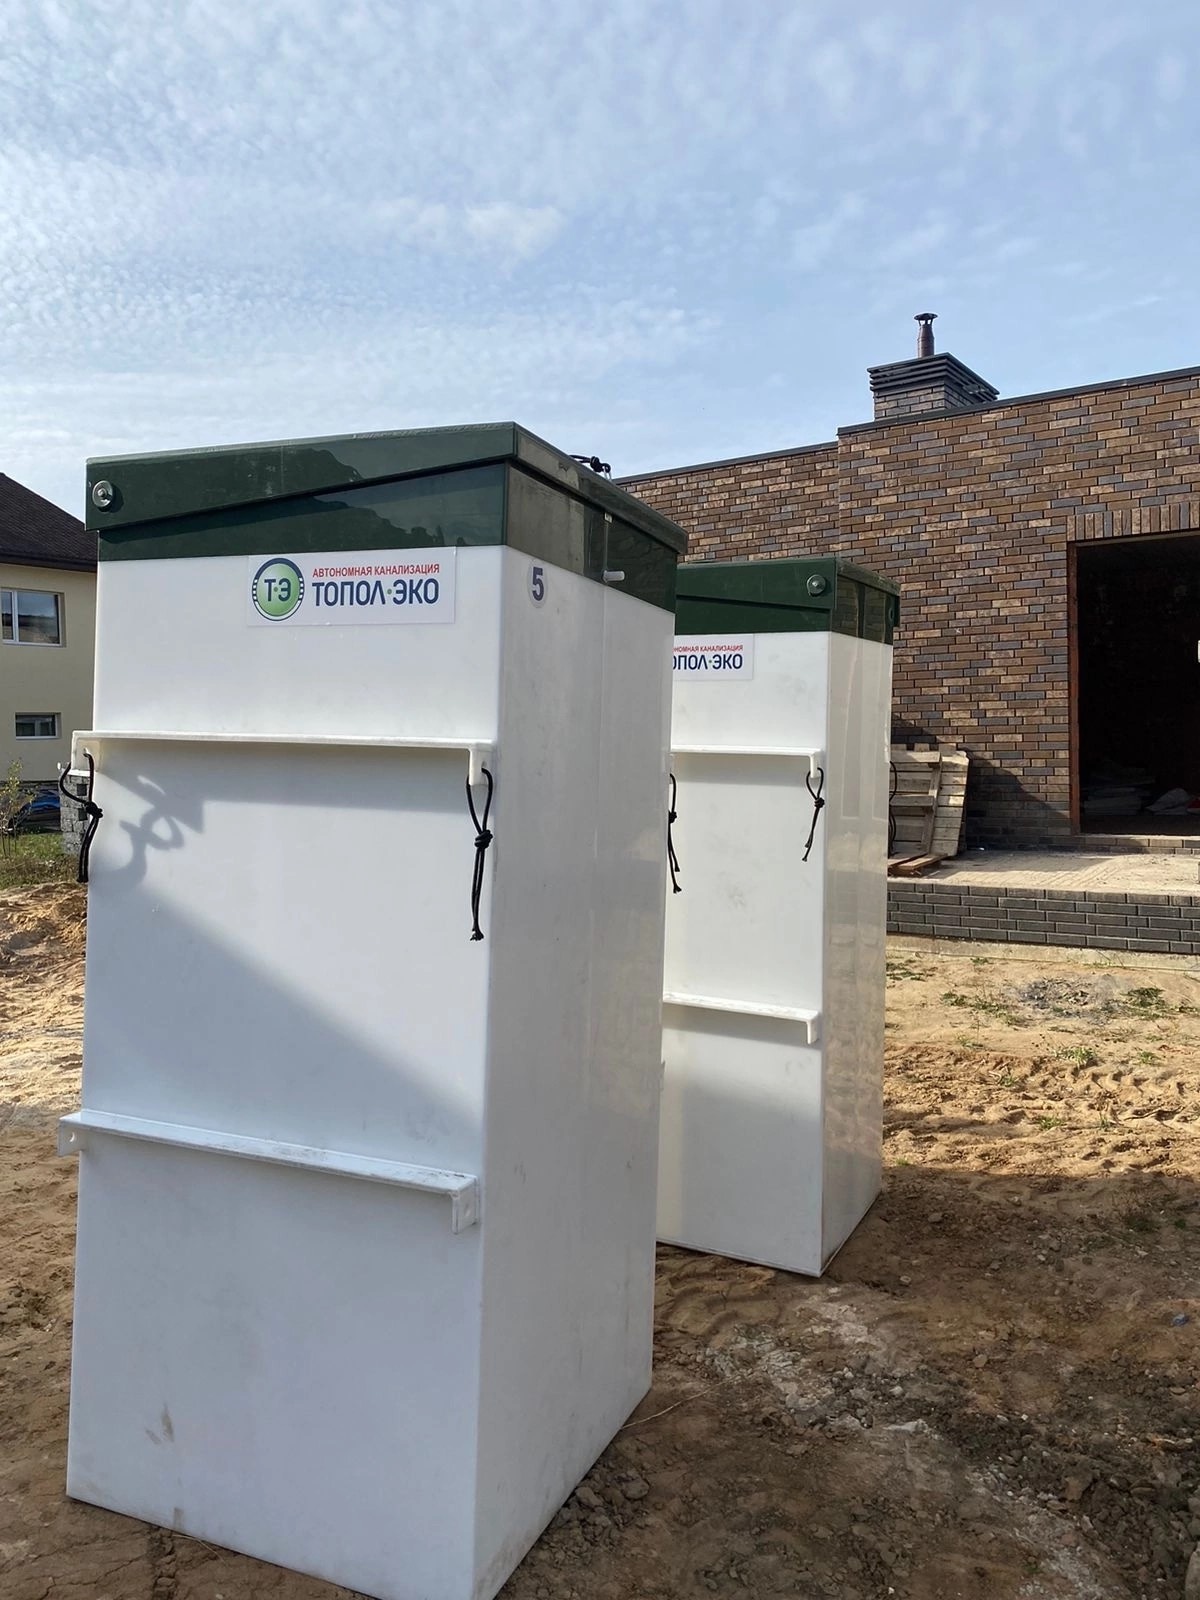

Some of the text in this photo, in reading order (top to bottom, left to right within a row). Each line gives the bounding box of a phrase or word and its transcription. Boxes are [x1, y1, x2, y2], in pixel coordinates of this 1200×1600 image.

[312, 563, 440, 578] АВТОНОМНАЯ КАНАЛИЗАЦИЯ
[532, 567, 545, 601] 5
[700, 644, 743, 653] КАНАЛИЗАЦИЯ
